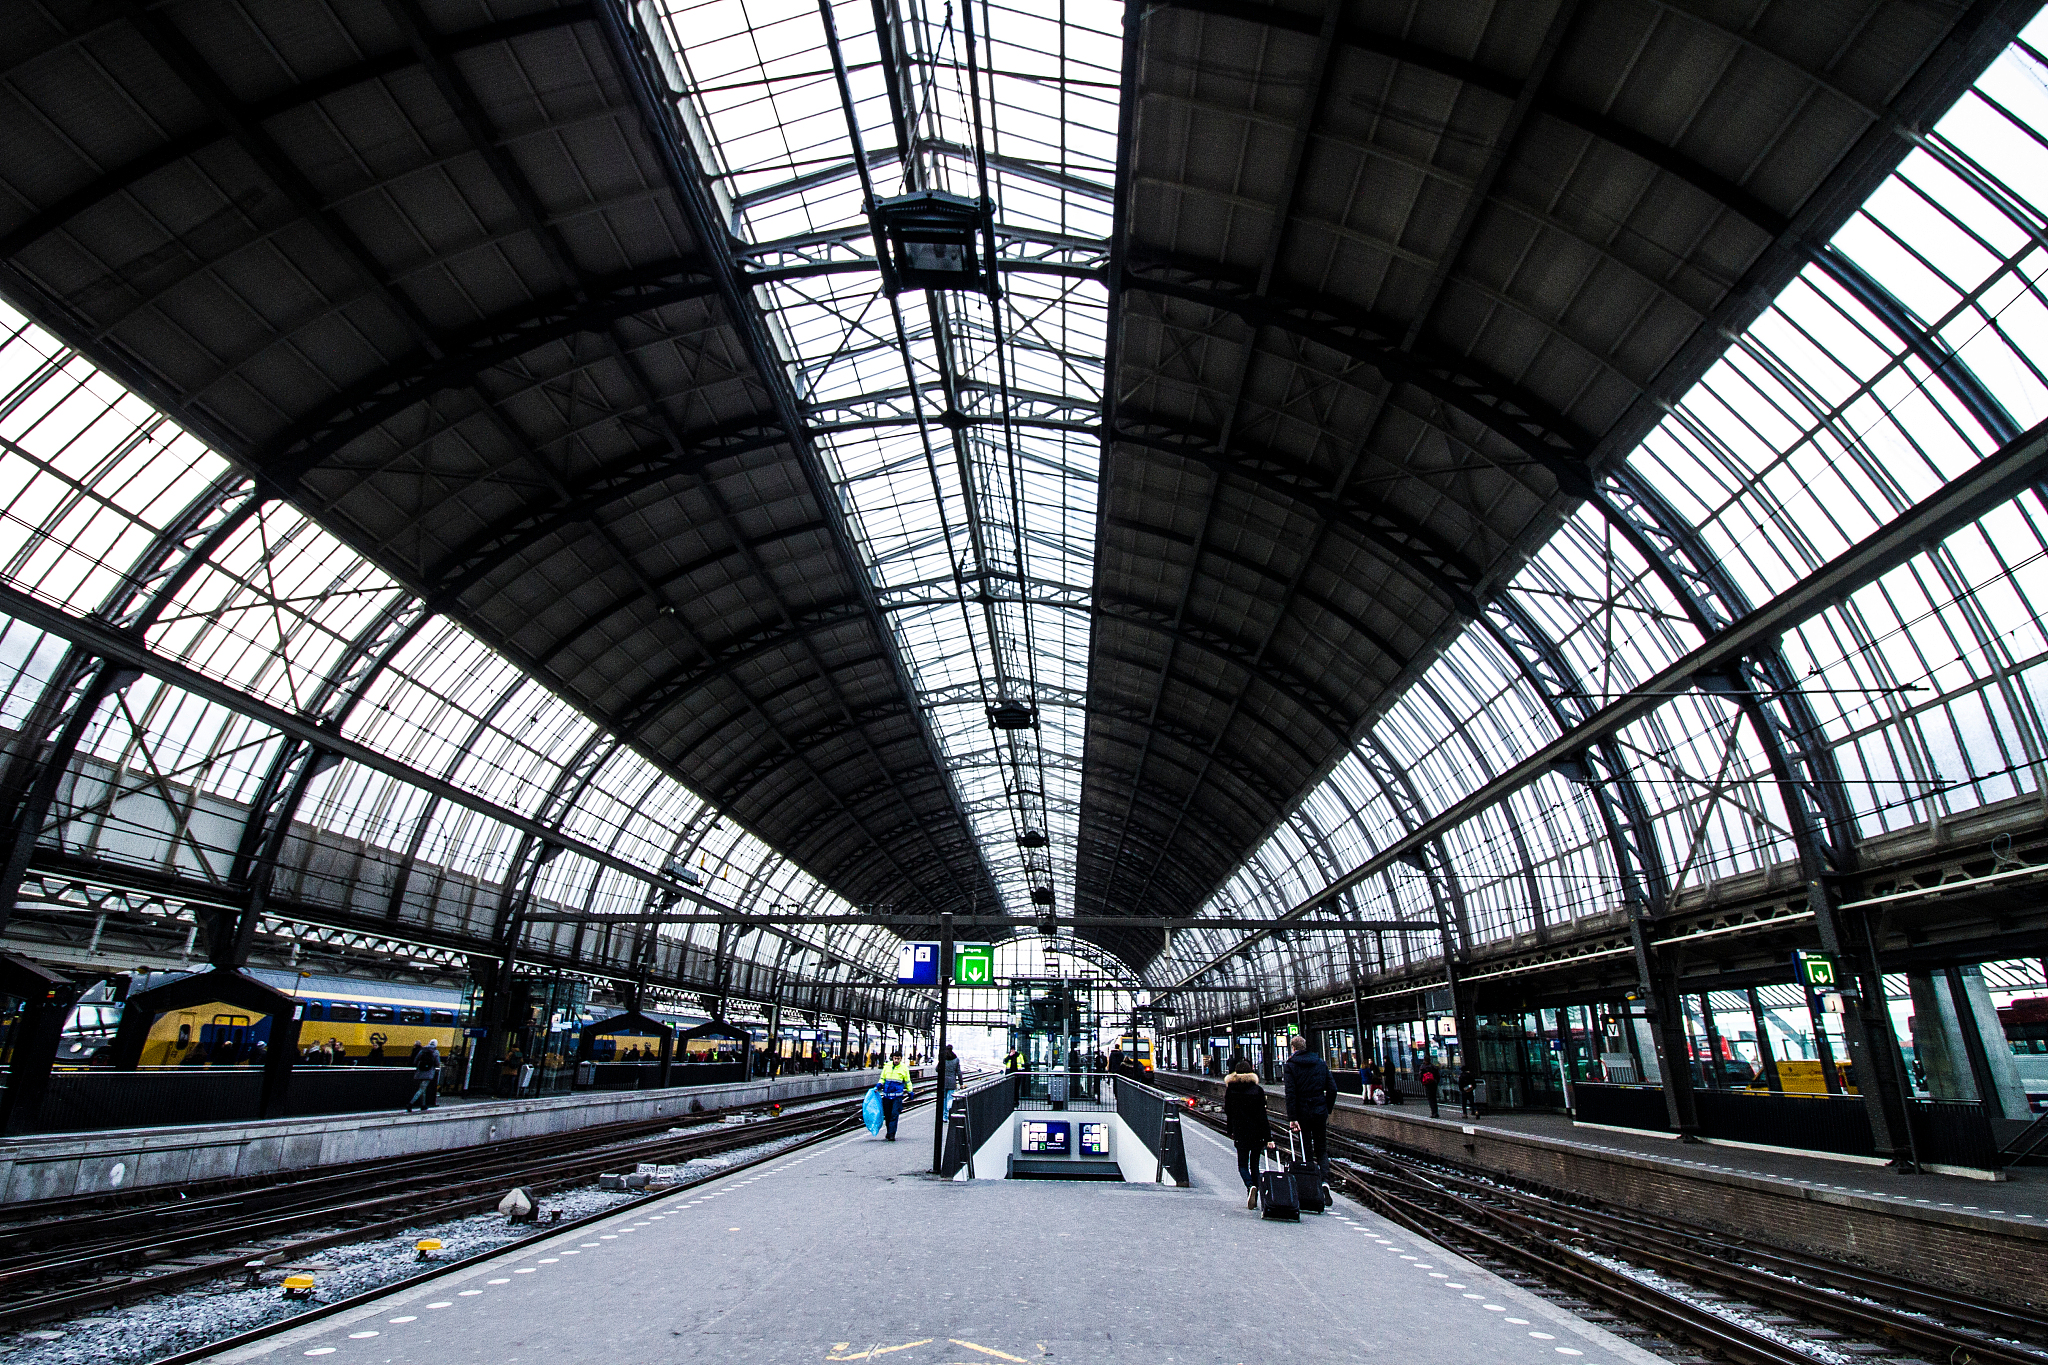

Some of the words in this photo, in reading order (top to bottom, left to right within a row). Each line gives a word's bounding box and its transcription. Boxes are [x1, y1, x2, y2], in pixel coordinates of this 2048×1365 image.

[360, 1011, 367, 1021] 2
[1167, 1017, 1175, 1027] V
[1608, 1024, 1617, 1035] V
